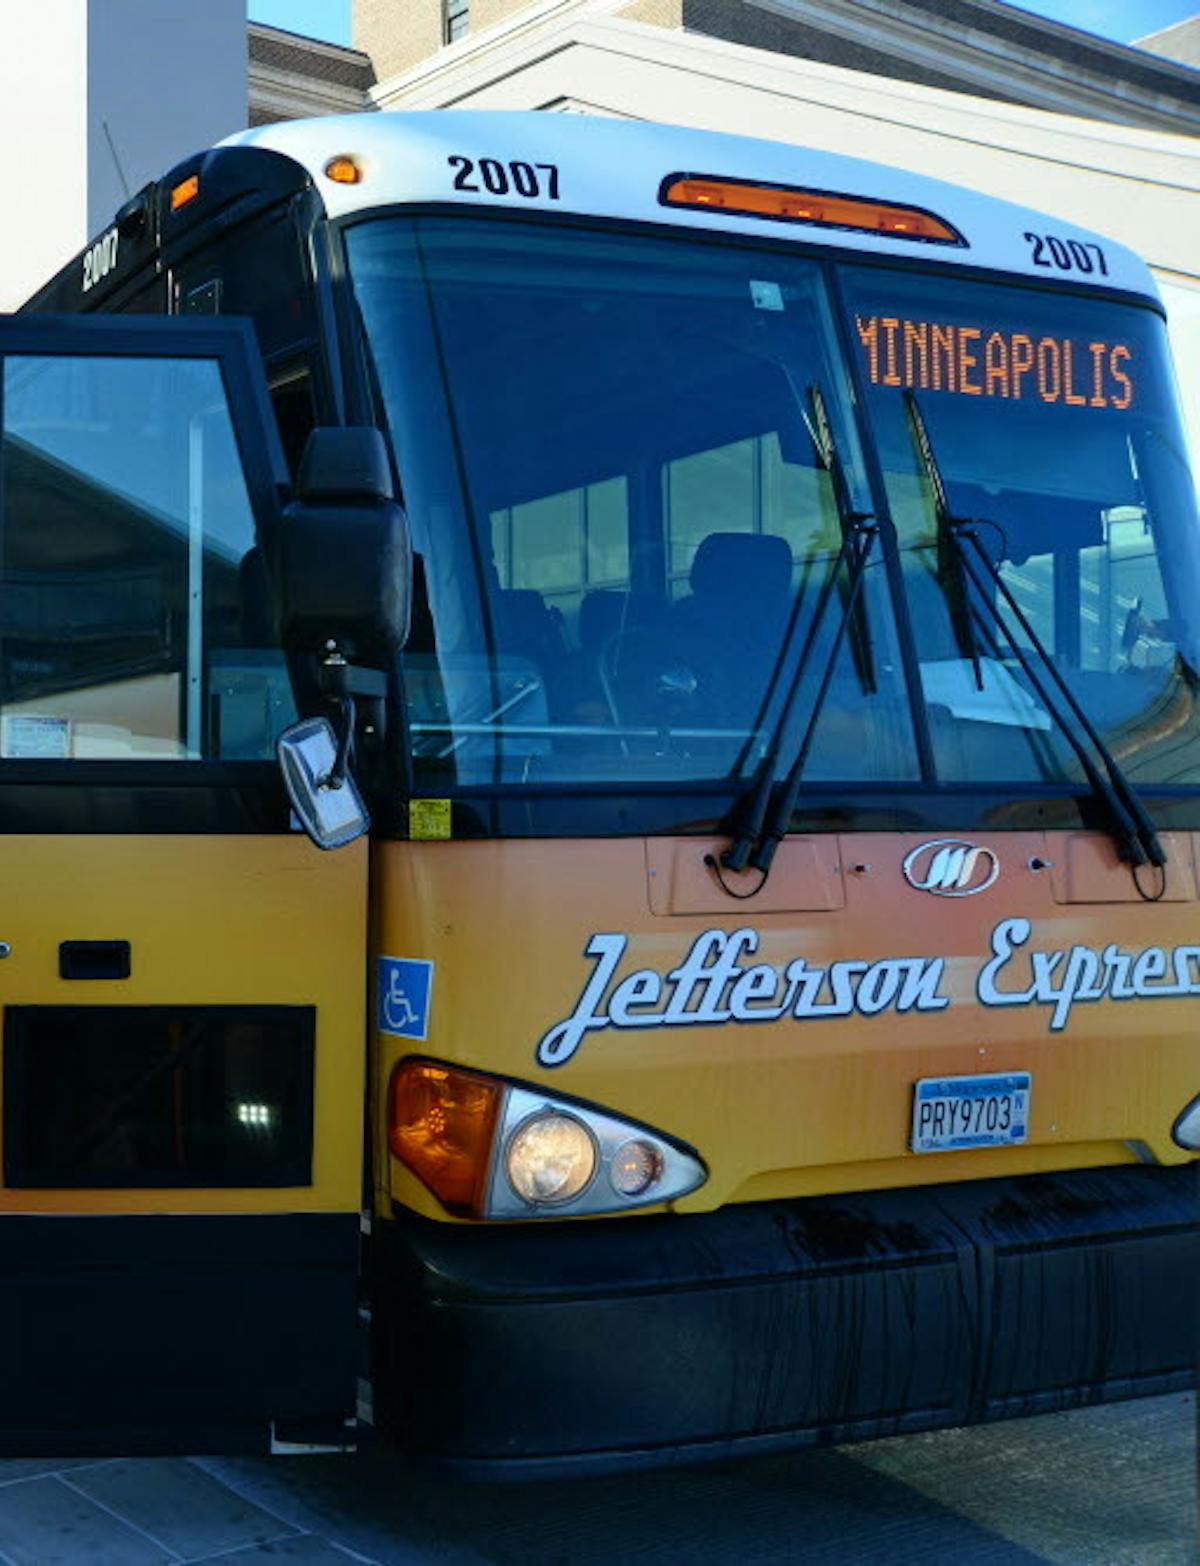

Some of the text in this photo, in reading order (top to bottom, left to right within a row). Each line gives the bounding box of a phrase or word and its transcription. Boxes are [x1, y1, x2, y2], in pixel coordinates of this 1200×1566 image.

[447, 155, 561, 200] 2007
[83, 227, 119, 292] 2007
[1025, 232, 1109, 277] 2007
[855, 314, 1132, 410] MINNEAPOLIS
[535, 917, 1200, 1068] Jefferson Expres
[918, 1096, 1011, 1138] PRY9703
